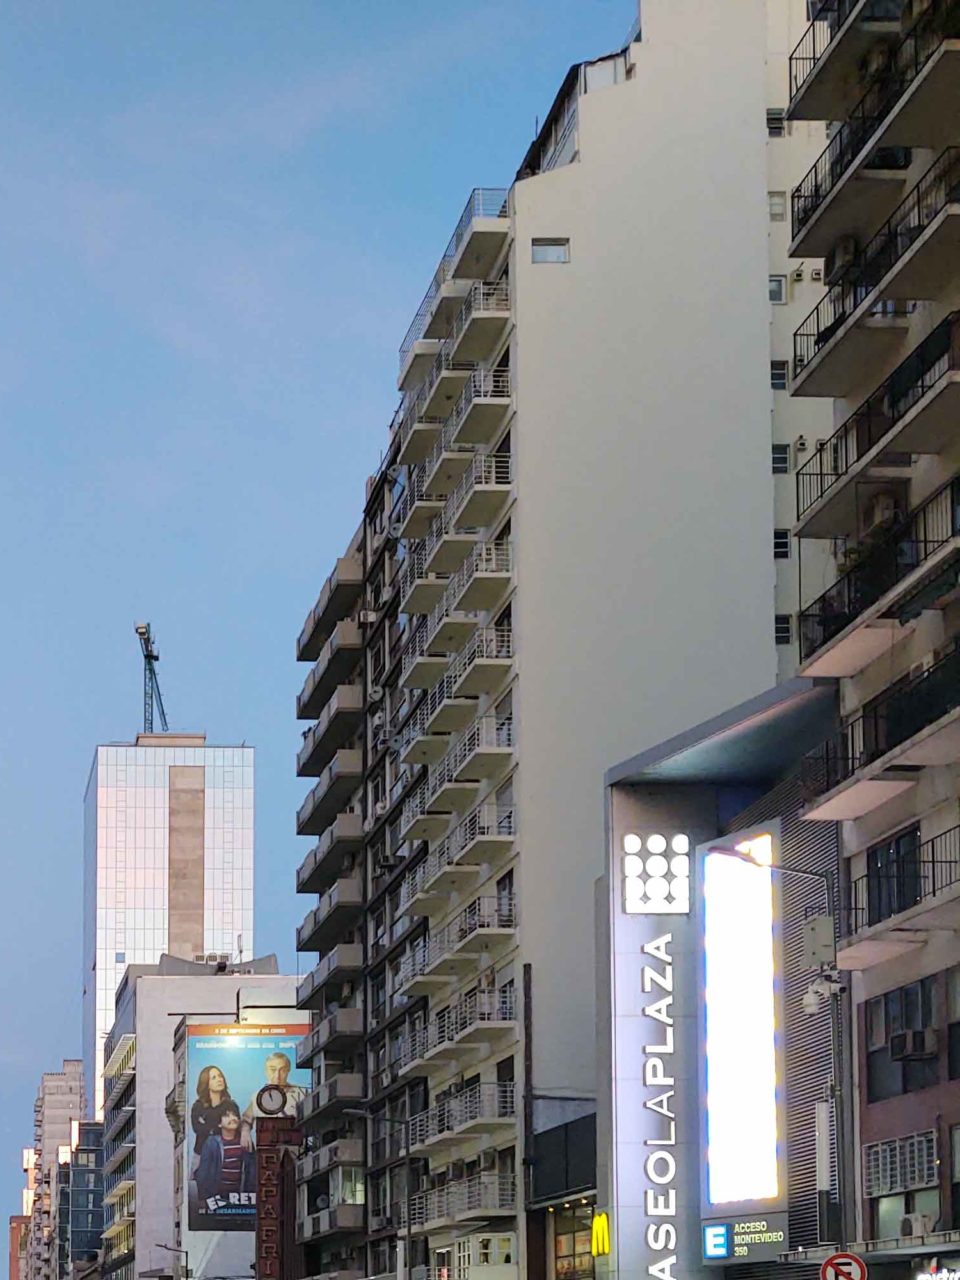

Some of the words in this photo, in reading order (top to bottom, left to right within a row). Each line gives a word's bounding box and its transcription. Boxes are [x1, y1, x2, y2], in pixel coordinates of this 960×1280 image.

[734, 1221, 767, 1233] ACCESO
[705, 1226, 727, 1257] E
[734, 1231, 784, 1244] MONTEVIDEO
[734, 1246, 748, 1257] 350
